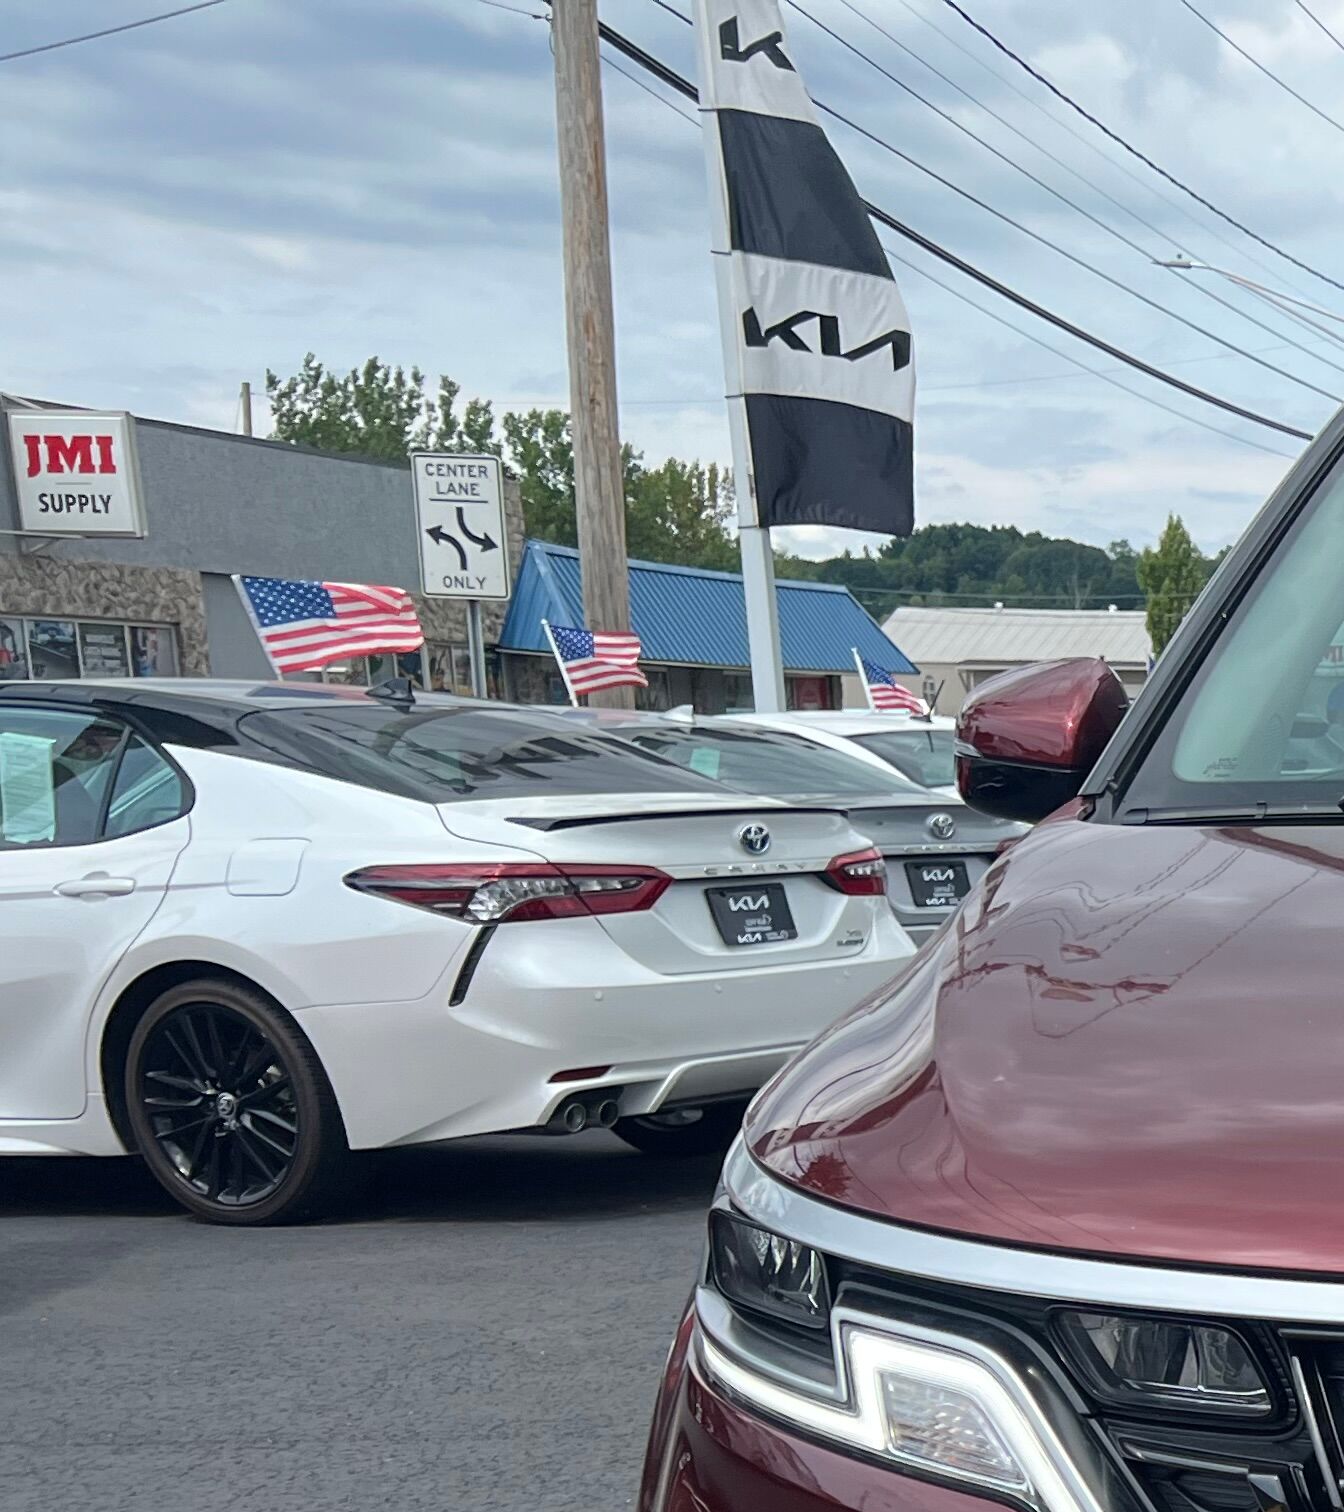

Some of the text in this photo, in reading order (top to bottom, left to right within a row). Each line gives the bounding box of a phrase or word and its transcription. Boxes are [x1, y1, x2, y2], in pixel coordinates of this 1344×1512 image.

[742, 306, 912, 372] KIA
[22, 434, 117, 478] JMI
[424, 463, 489, 479] CENTER
[435, 481, 481, 496] LANE
[38, 492, 113, 514] SUPPLY
[442, 575, 486, 590] ONLY
[922, 868, 955, 882] KIA
[728, 894, 770, 912] KIA
